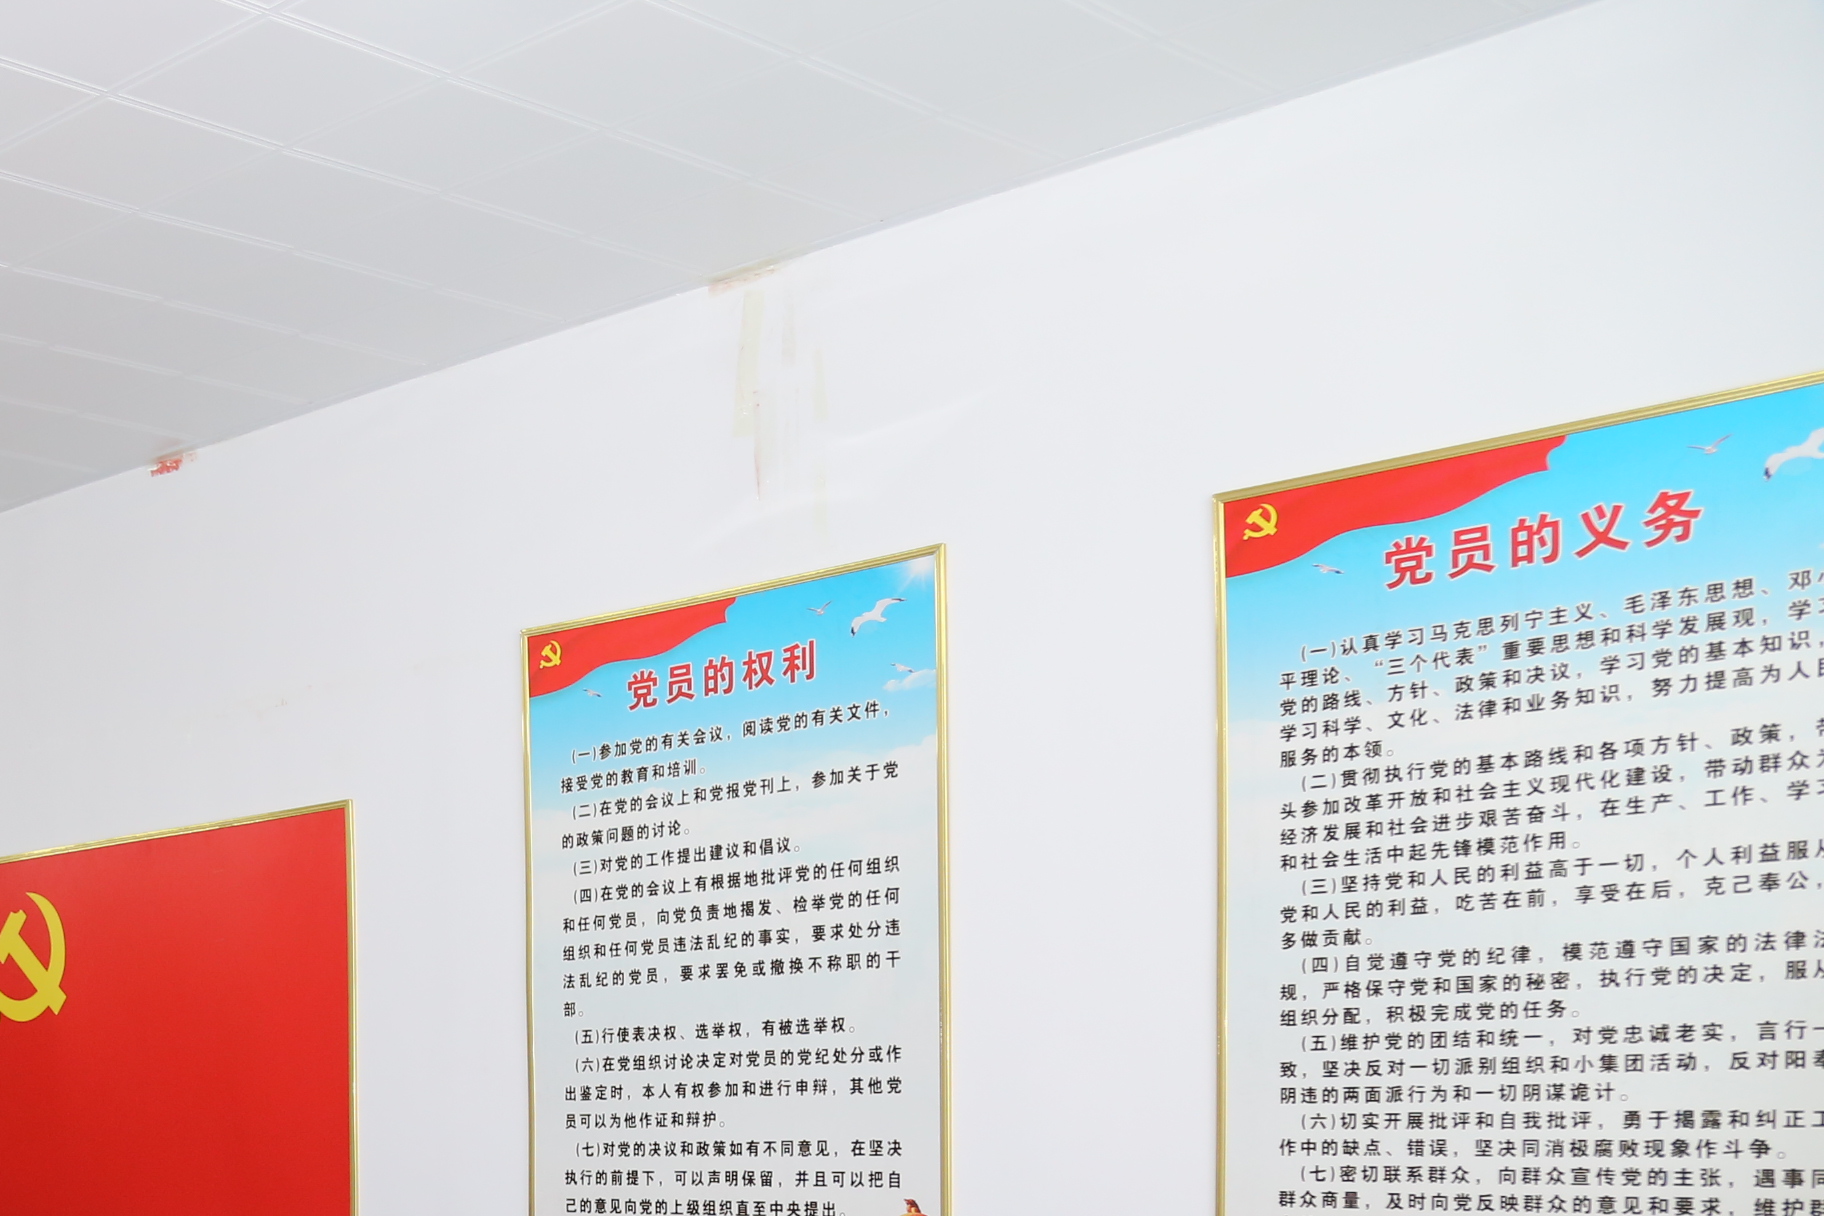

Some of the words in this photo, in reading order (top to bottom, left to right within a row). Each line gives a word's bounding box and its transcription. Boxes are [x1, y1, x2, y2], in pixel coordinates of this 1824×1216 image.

[1384, 488, 1704, 590] 党员的义务
[626, 639, 817, 712] 党员的权利
[1279, 657, 1824, 743] 学习科学、文化、法律和业务知识，努力提高为人
[1279, 739, 1394, 769] 服务的本领。
[560, 757, 706, 795] 接受党的教育和培训。
[561, 818, 690, 850] 的政策问题的讨论。
[1279, 830, 1580, 873] 和社会生活中起先锋模范作用。
[1280, 927, 1373, 951] 多做贡献。
[562, 1000, 584, 1018] 部。
[1279, 998, 1580, 1027] 组织分配，积极完成党的任务。
[565, 1110, 726, 1130] 员可以为他作证和辩护。
